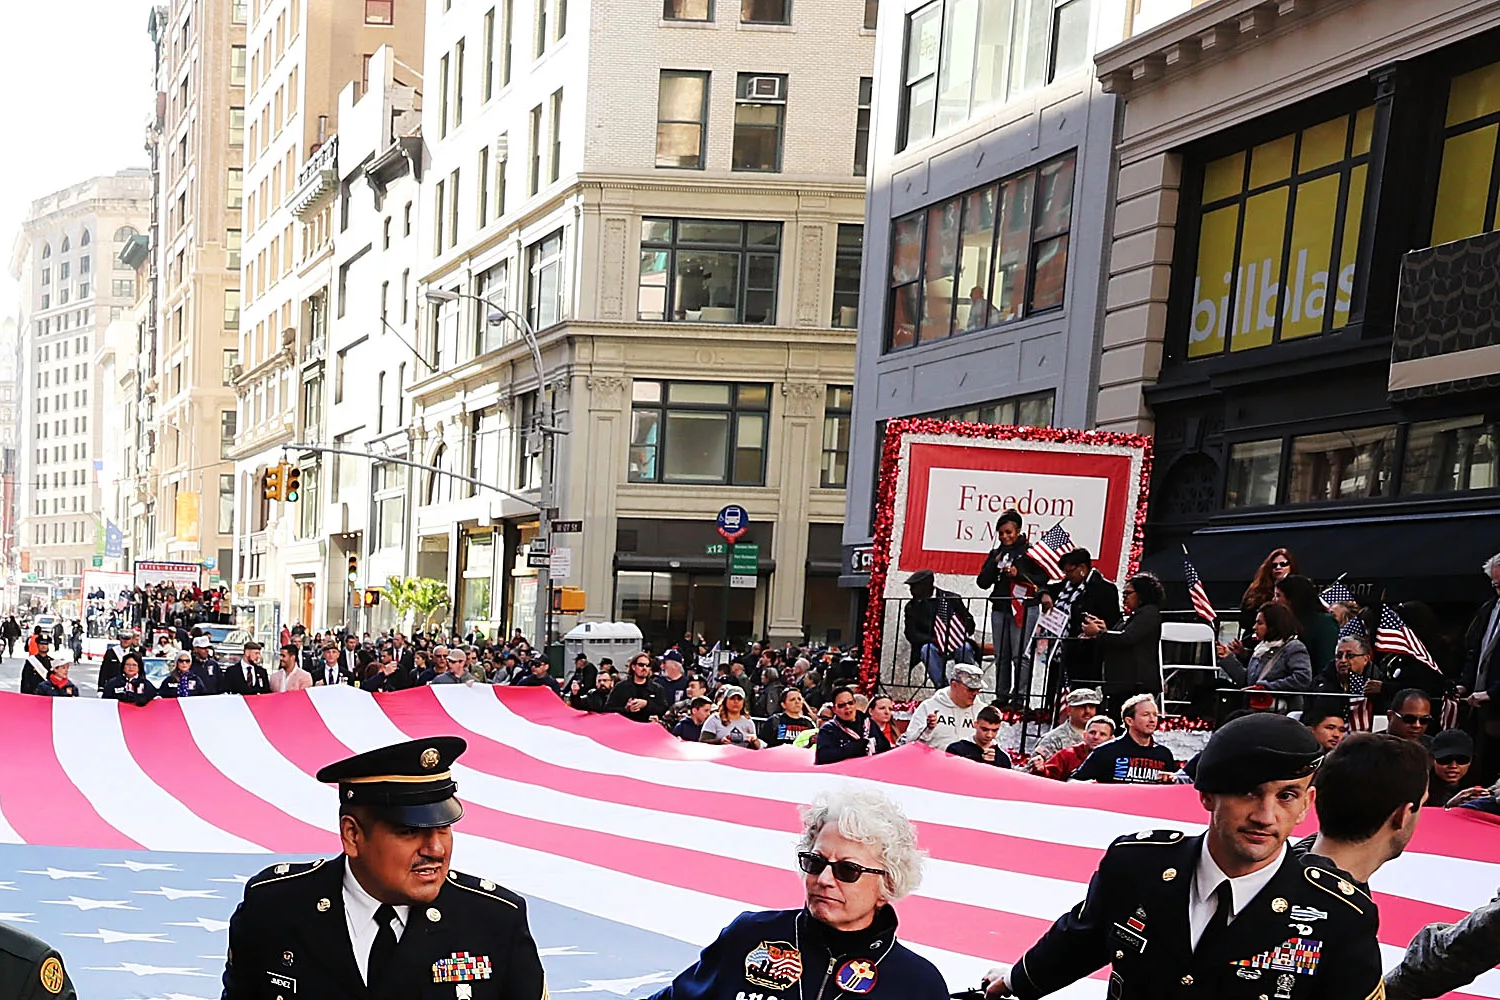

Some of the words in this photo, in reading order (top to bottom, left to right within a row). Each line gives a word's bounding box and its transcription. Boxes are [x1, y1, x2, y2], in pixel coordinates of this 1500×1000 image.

[958, 485, 1075, 518] Freedom
[956, 519, 973, 541] Is
[1114, 757, 1128, 777] NYC
